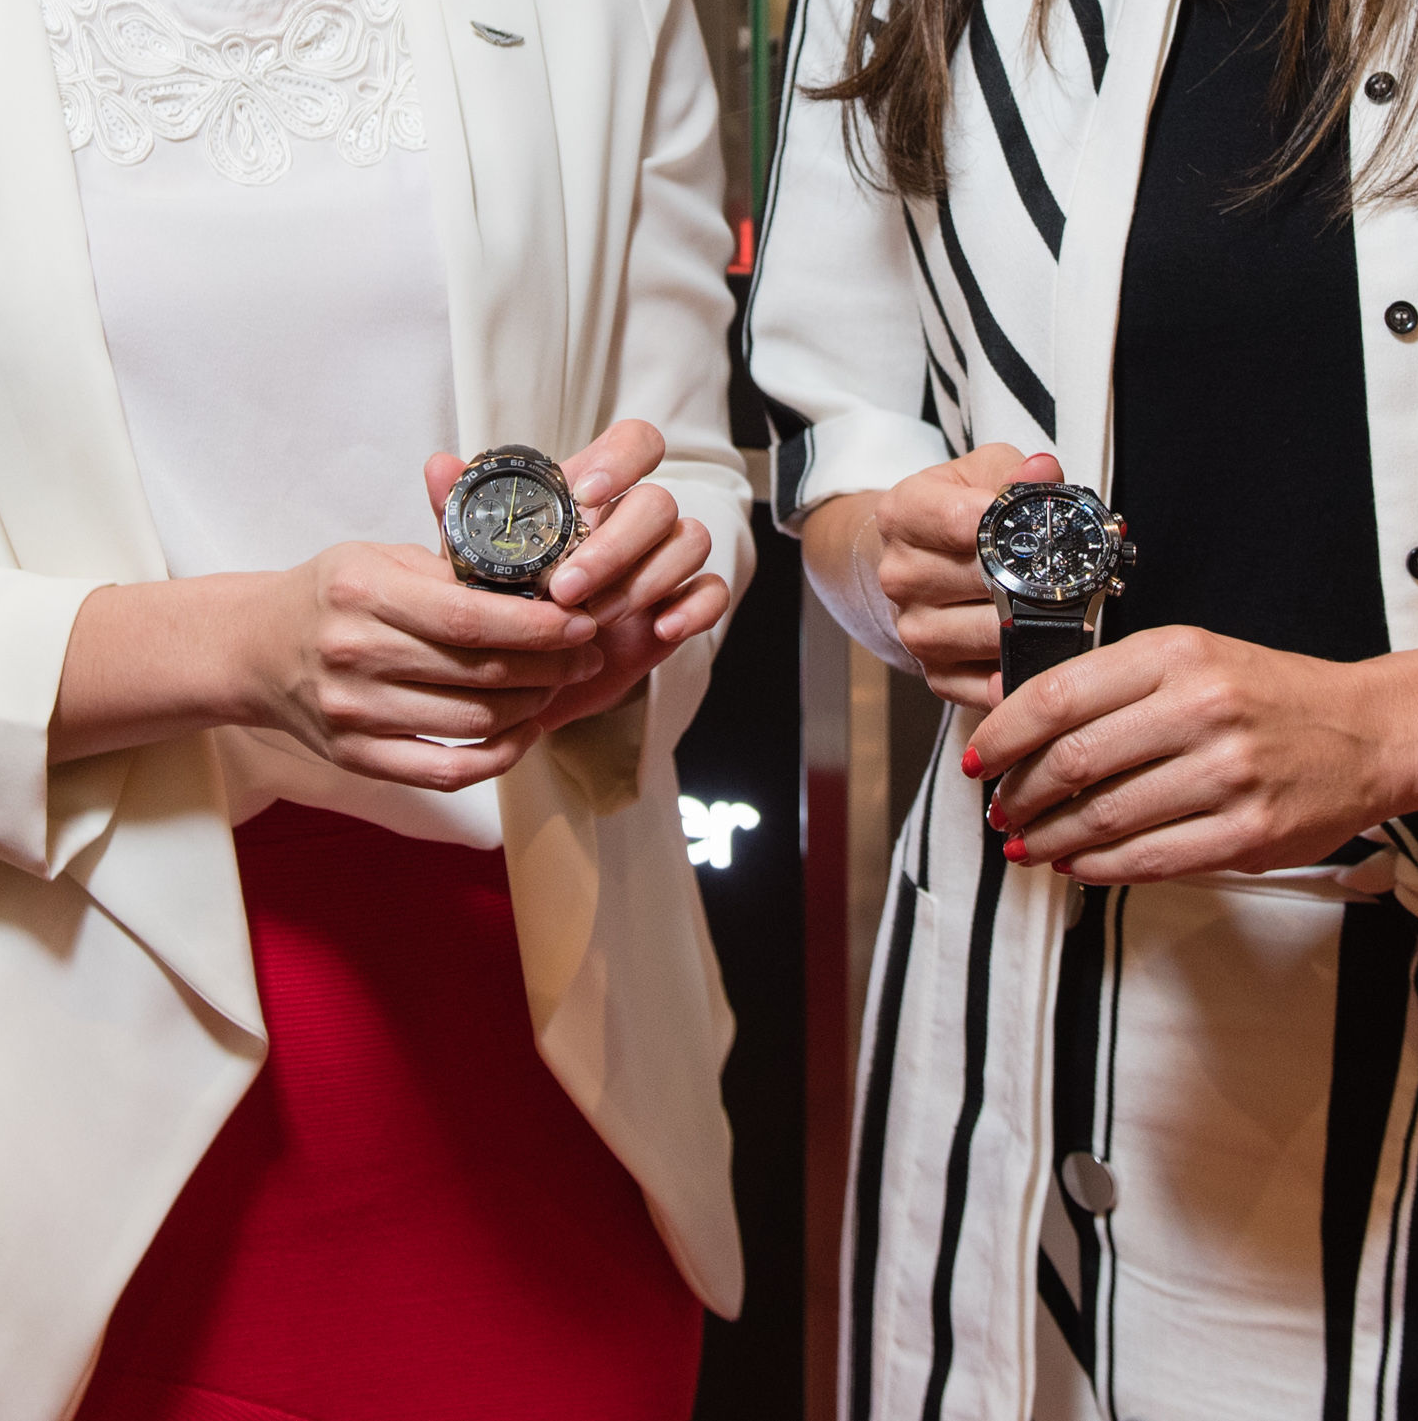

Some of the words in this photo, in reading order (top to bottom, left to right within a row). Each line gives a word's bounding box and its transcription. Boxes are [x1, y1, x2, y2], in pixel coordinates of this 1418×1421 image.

[482, 461, 498, 471] 65
[510, 459, 525, 468] 60
[463, 470, 478, 483] 70
[448, 501, 458, 516] 80
[562, 513, 572, 535] 240
[451, 528, 463, 544] 90
[462, 545, 480, 564] 100
[548, 541, 565, 558] 180
[493, 564, 513, 575] 120
[523, 560, 542, 573] 145
